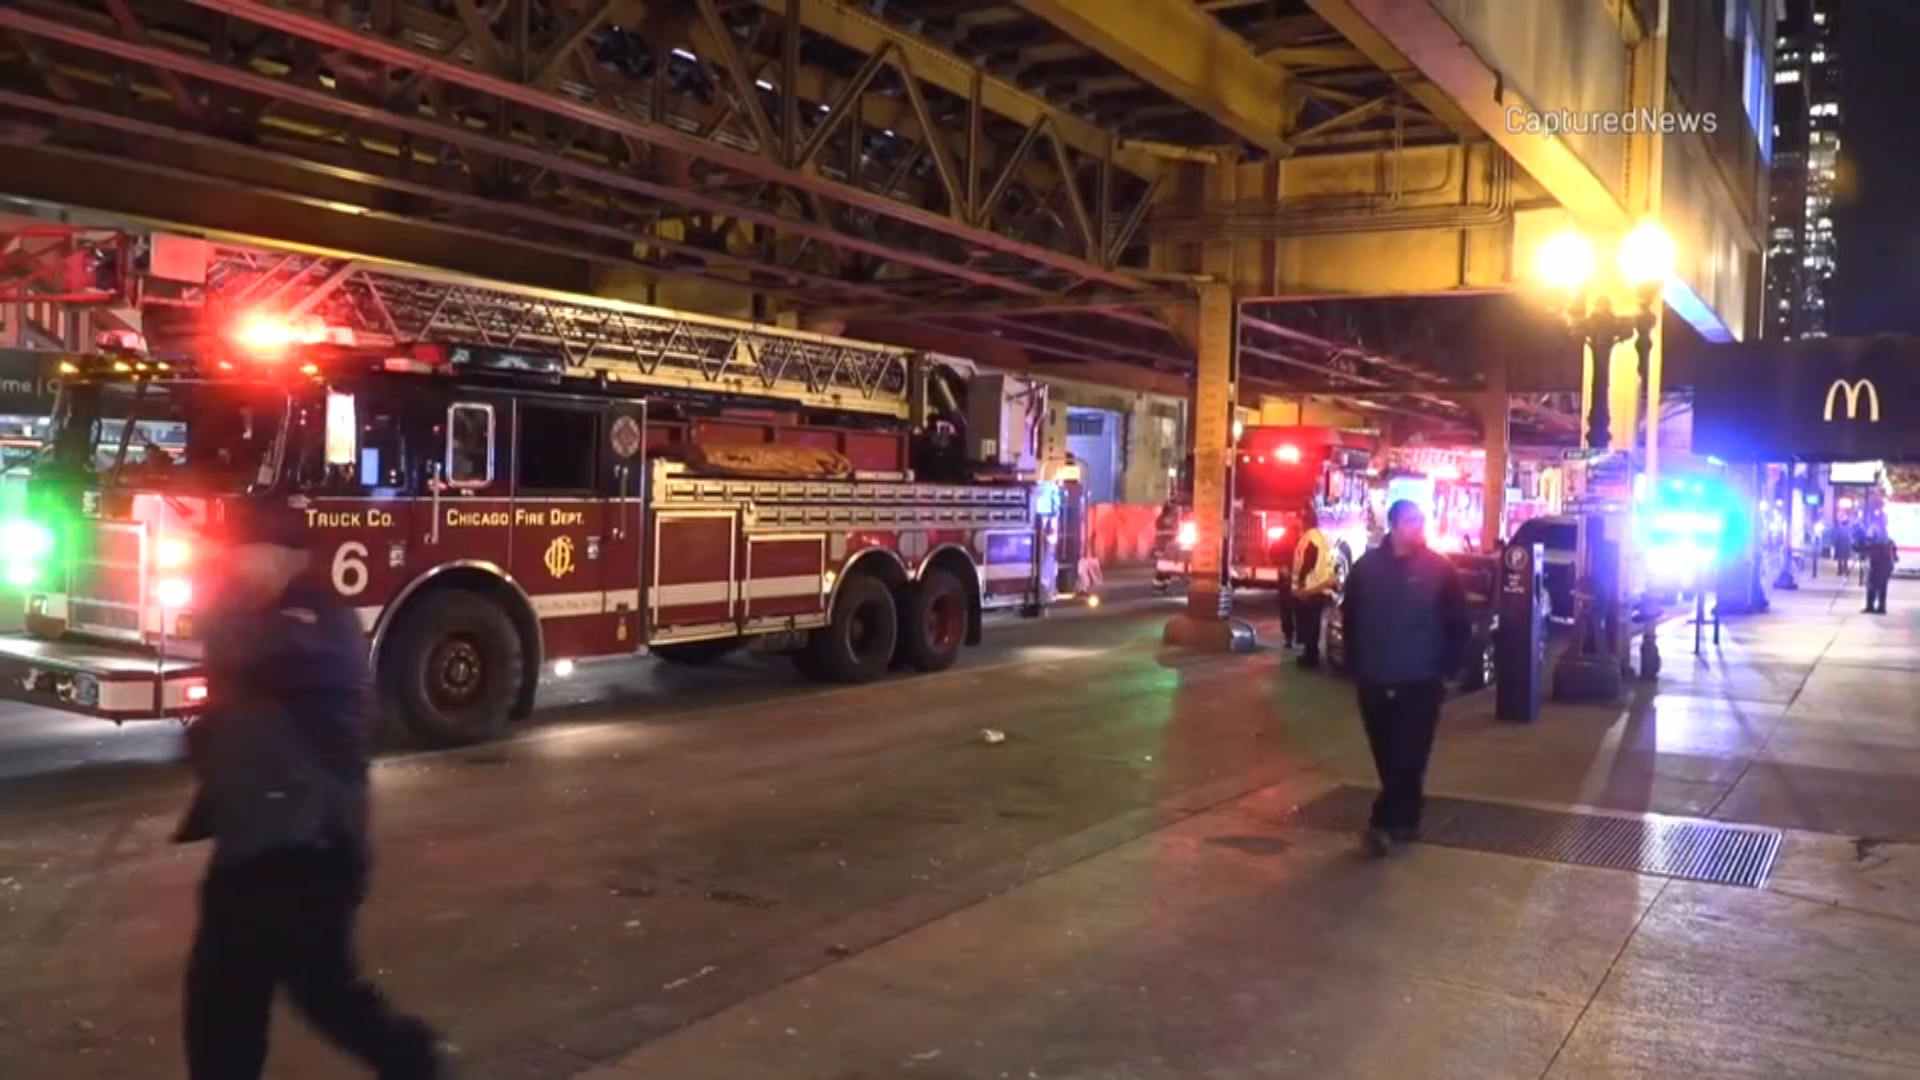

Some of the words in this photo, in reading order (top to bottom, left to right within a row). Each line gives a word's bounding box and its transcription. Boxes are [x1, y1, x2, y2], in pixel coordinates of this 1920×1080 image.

[304, 508, 361, 528] TRUCK
[446, 508, 509, 527] CHICAGO
[515, 508, 545, 527] FIRE
[550, 508, 585, 527] DEPT.
[331, 541, 369, 596] 6
